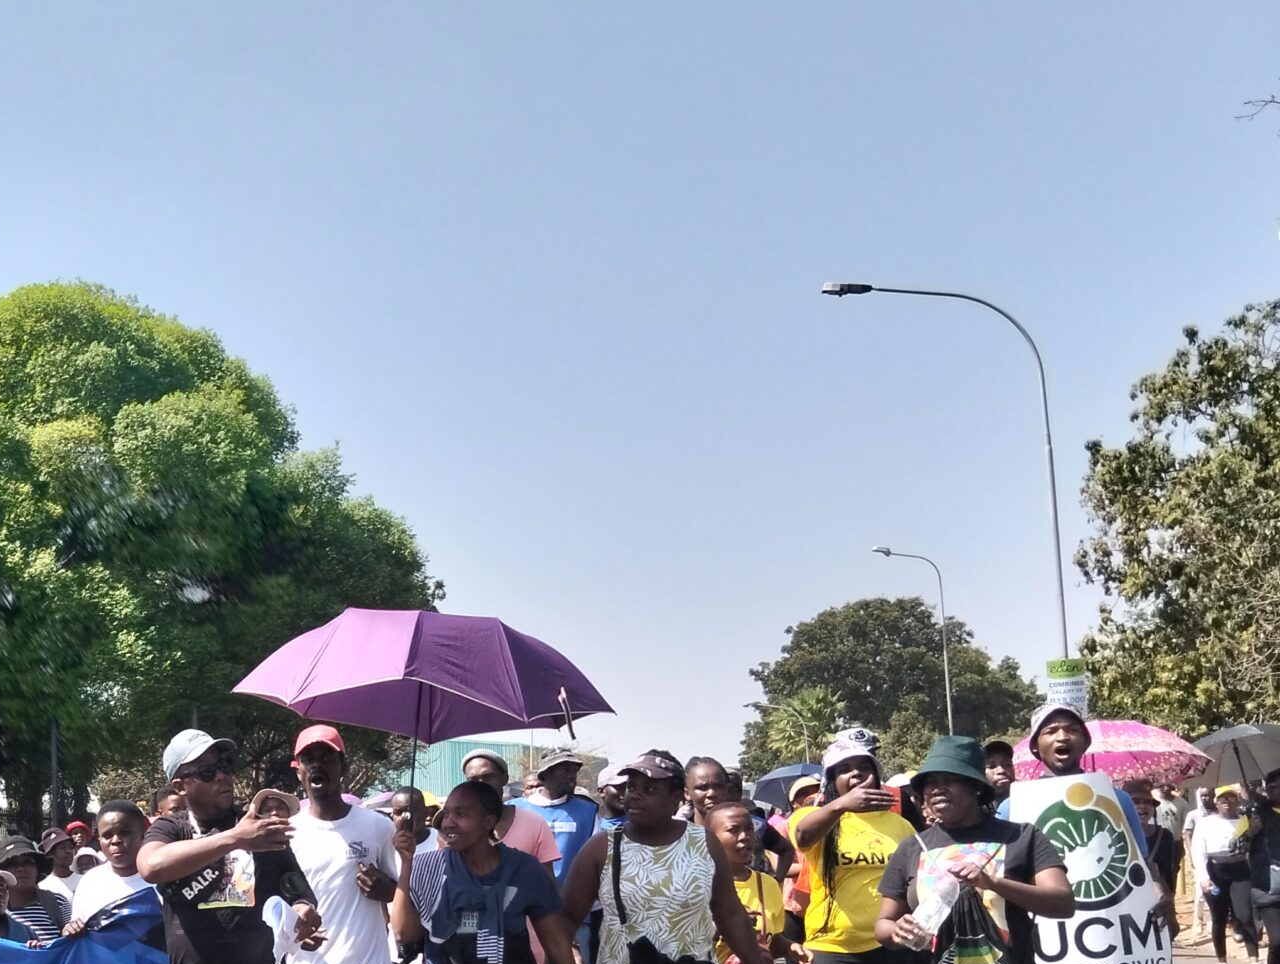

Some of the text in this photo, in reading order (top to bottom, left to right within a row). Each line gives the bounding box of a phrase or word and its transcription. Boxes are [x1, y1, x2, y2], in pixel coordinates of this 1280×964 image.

[1050, 660, 1083, 673] eden
[1048, 680, 1085, 688] COMBINED
[181, 868, 220, 900] BALR.
[1033, 913, 1164, 963] UCM
